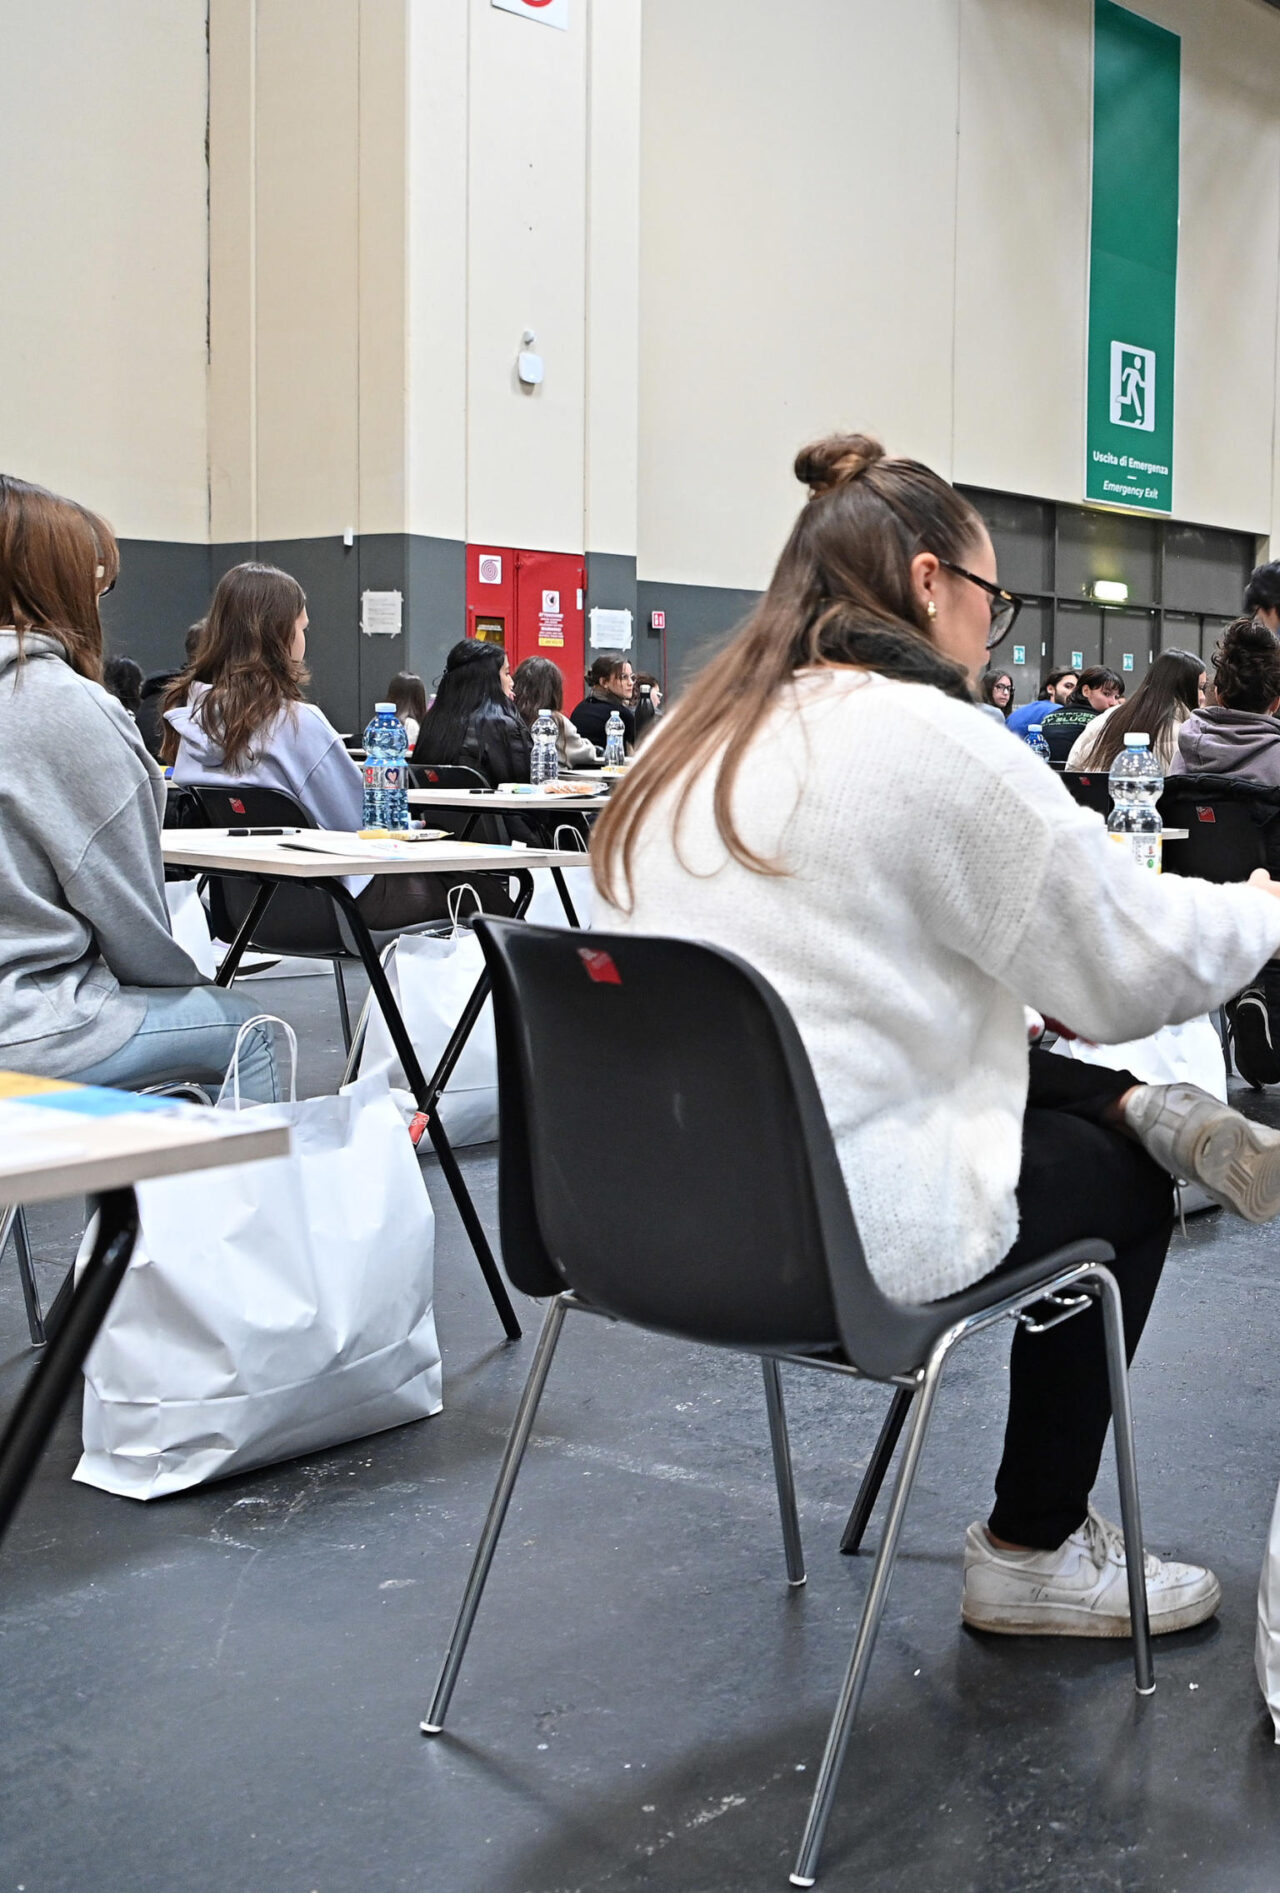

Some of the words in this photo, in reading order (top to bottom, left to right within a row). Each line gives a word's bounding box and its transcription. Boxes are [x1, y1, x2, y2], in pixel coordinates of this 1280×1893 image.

[1093, 450, 1118, 465] Uscita
[1119, 456, 1128, 467] di
[1128, 457, 1169, 475] Emergenza
[1103, 480, 1144, 498] Emergency
[1144, 488, 1159, 499] Exit
